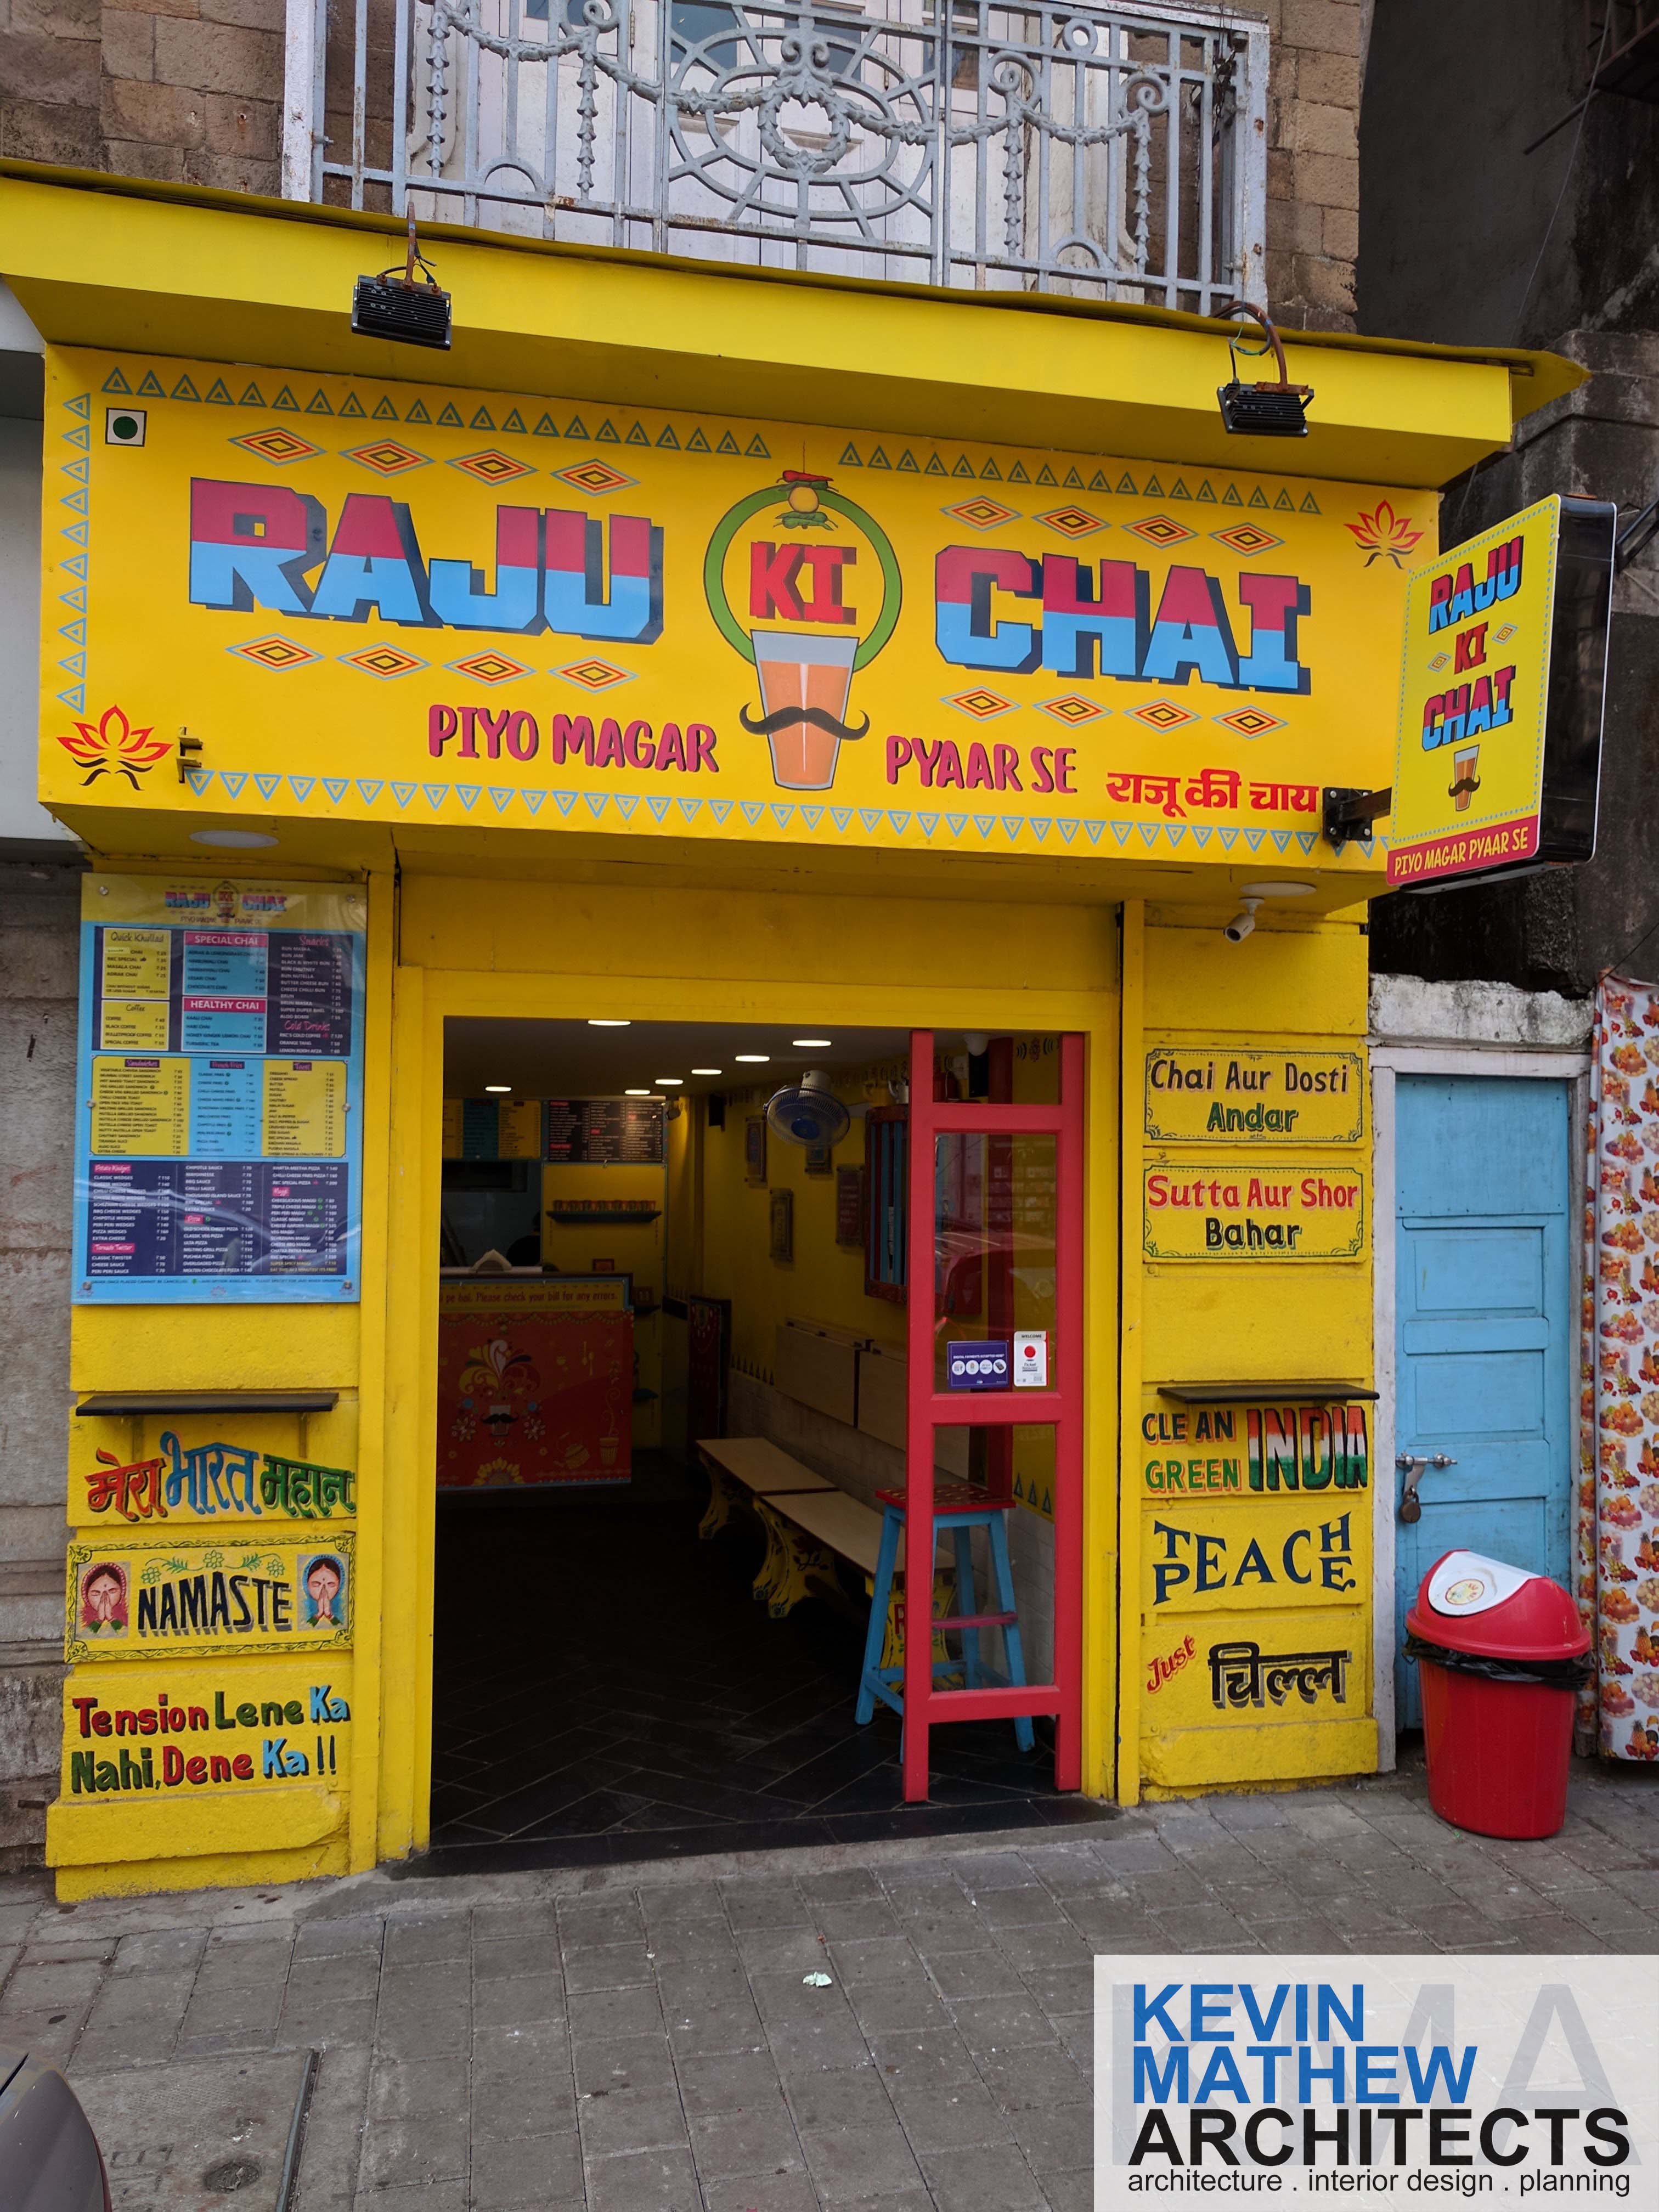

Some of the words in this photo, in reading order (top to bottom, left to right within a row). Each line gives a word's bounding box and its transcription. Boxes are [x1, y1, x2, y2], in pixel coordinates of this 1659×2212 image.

[189, 477, 664, 646] RAJU
[749, 540, 857, 624] KI
[934, 544, 1312, 696] CHAI
[1428, 535, 1524, 634] RAJU
[1453, 620, 1489, 675] KI
[1421, 664, 1516, 752] CHAI
[428, 703, 539, 761] PIYO
[552, 713, 719, 773] MAGAR
[885, 733, 1024, 790] PYAAR
[1030, 746, 1079, 794] SE
[1105, 770, 1184, 818] राजू
[1186, 767, 1242, 811] की
[1249, 785, 1319, 814] चाय
[1393, 854, 1423, 878] PIYO
[1425, 842, 1466, 868] MAGAR
[1468, 833, 1509, 859] PYAAR
[1512, 826, 1528, 850] SE
[165, 891, 211, 909] RAJU
[242, 895, 287, 911] CHAI
[195, 935, 232, 944] SPECIAL
[191, 1001, 234, 1009] HEALTHY
[236, 1001, 259, 1010] CHAI
[284, 1020, 302, 1030] Cold
[1150, 1059, 1215, 1093] Chai
[1224, 1060, 1273, 1094] Aur
[1285, 1062, 1350, 1094] Dosti
[1206, 1102, 1299, 1132] Andar
[1147, 1175, 1242, 1211] Sutta
[1246, 1177, 1295, 1211] Aur
[1300, 1178, 1358, 1211] Shor
[1205, 1217, 1302, 1250] Bahar
[476, 1291, 501, 1302] Please
[504, 1291, 526, 1302] check
[529, 1294, 545, 1304] your
[547, 1291, 560, 1301] bill
[562, 1291, 573, 1301] for
[576, 1293, 590, 1302] any
[592, 1291, 618, 1300] errors.
[1142, 1410, 1238, 1446] CLEAN
[1246, 1405, 1368, 1492] INDIA
[84, 1447, 168, 1522] मेरा
[160, 1429, 262, 1515] भारत
[260, 1453, 357, 1520] महान
[1145, 1458, 1243, 1494] GREEN
[138, 1571, 292, 1637] NAMASTE
[1146, 1634, 1198, 1694] Just
[72, 1694, 210, 1739] Tension
[215, 1690, 305, 1730] Lene
[309, 1684, 351, 1724] Ka
[162, 1745, 255, 1787] Dene
[263, 1737, 309, 1779] Ka
